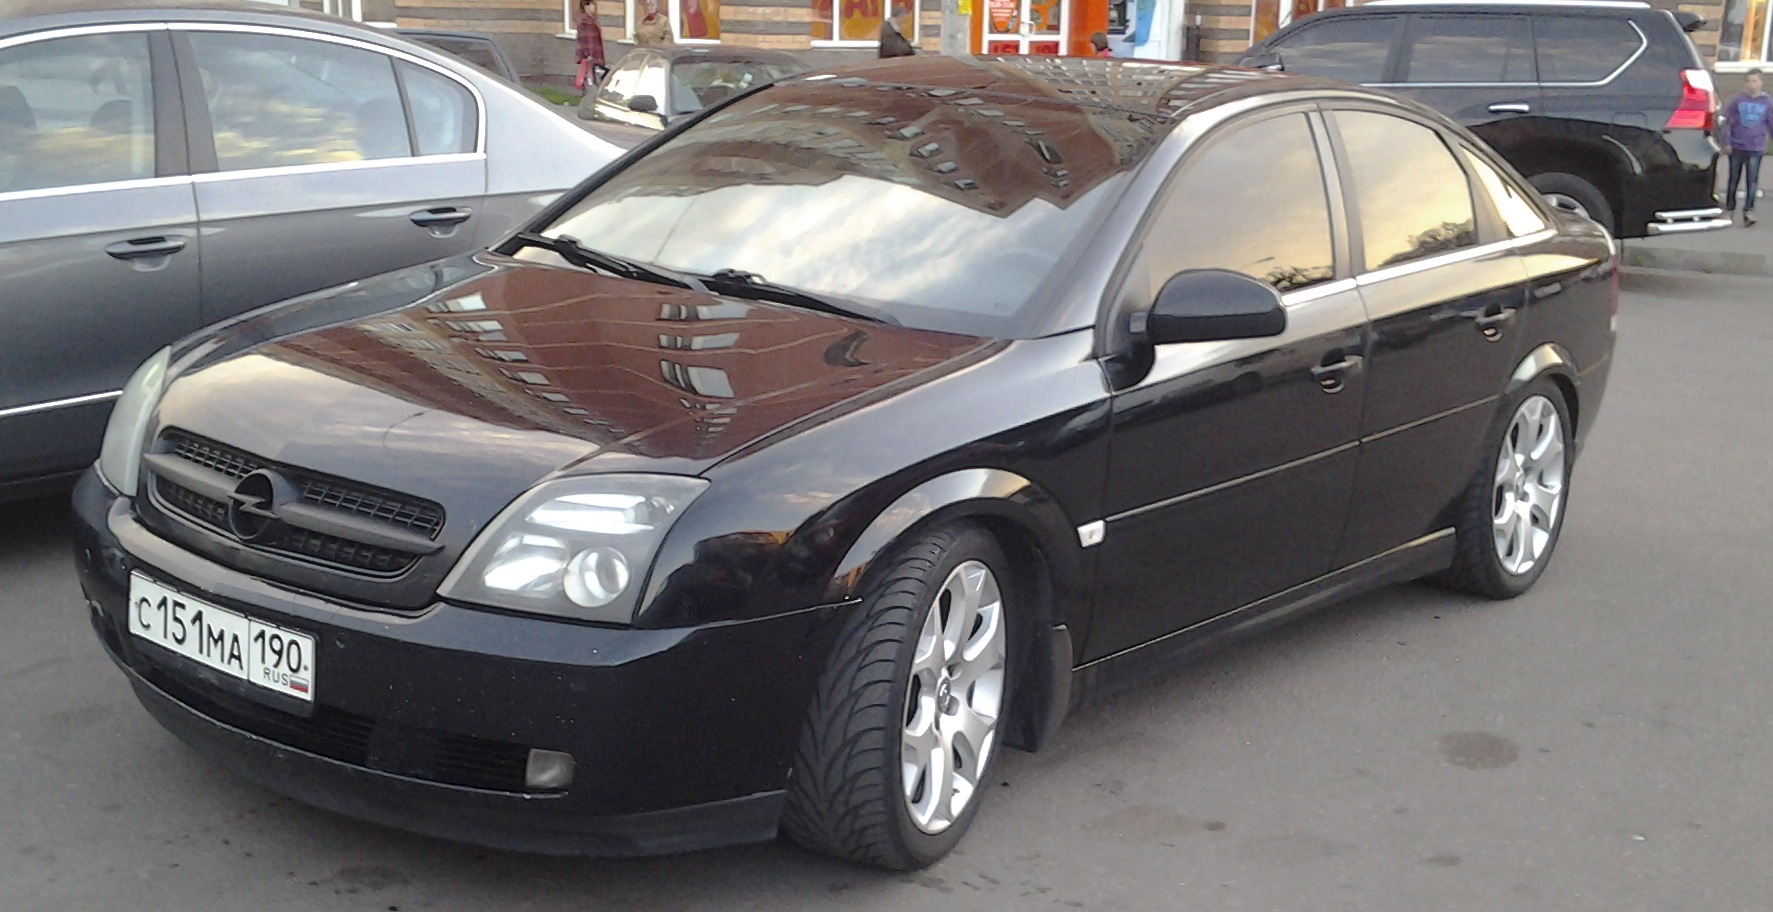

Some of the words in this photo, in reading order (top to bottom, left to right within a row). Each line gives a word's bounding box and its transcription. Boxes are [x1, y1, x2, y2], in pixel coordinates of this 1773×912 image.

[137, 594, 244, 671] С151МА
[253, 628, 302, 674] 190
[262, 667, 289, 687] RUS
